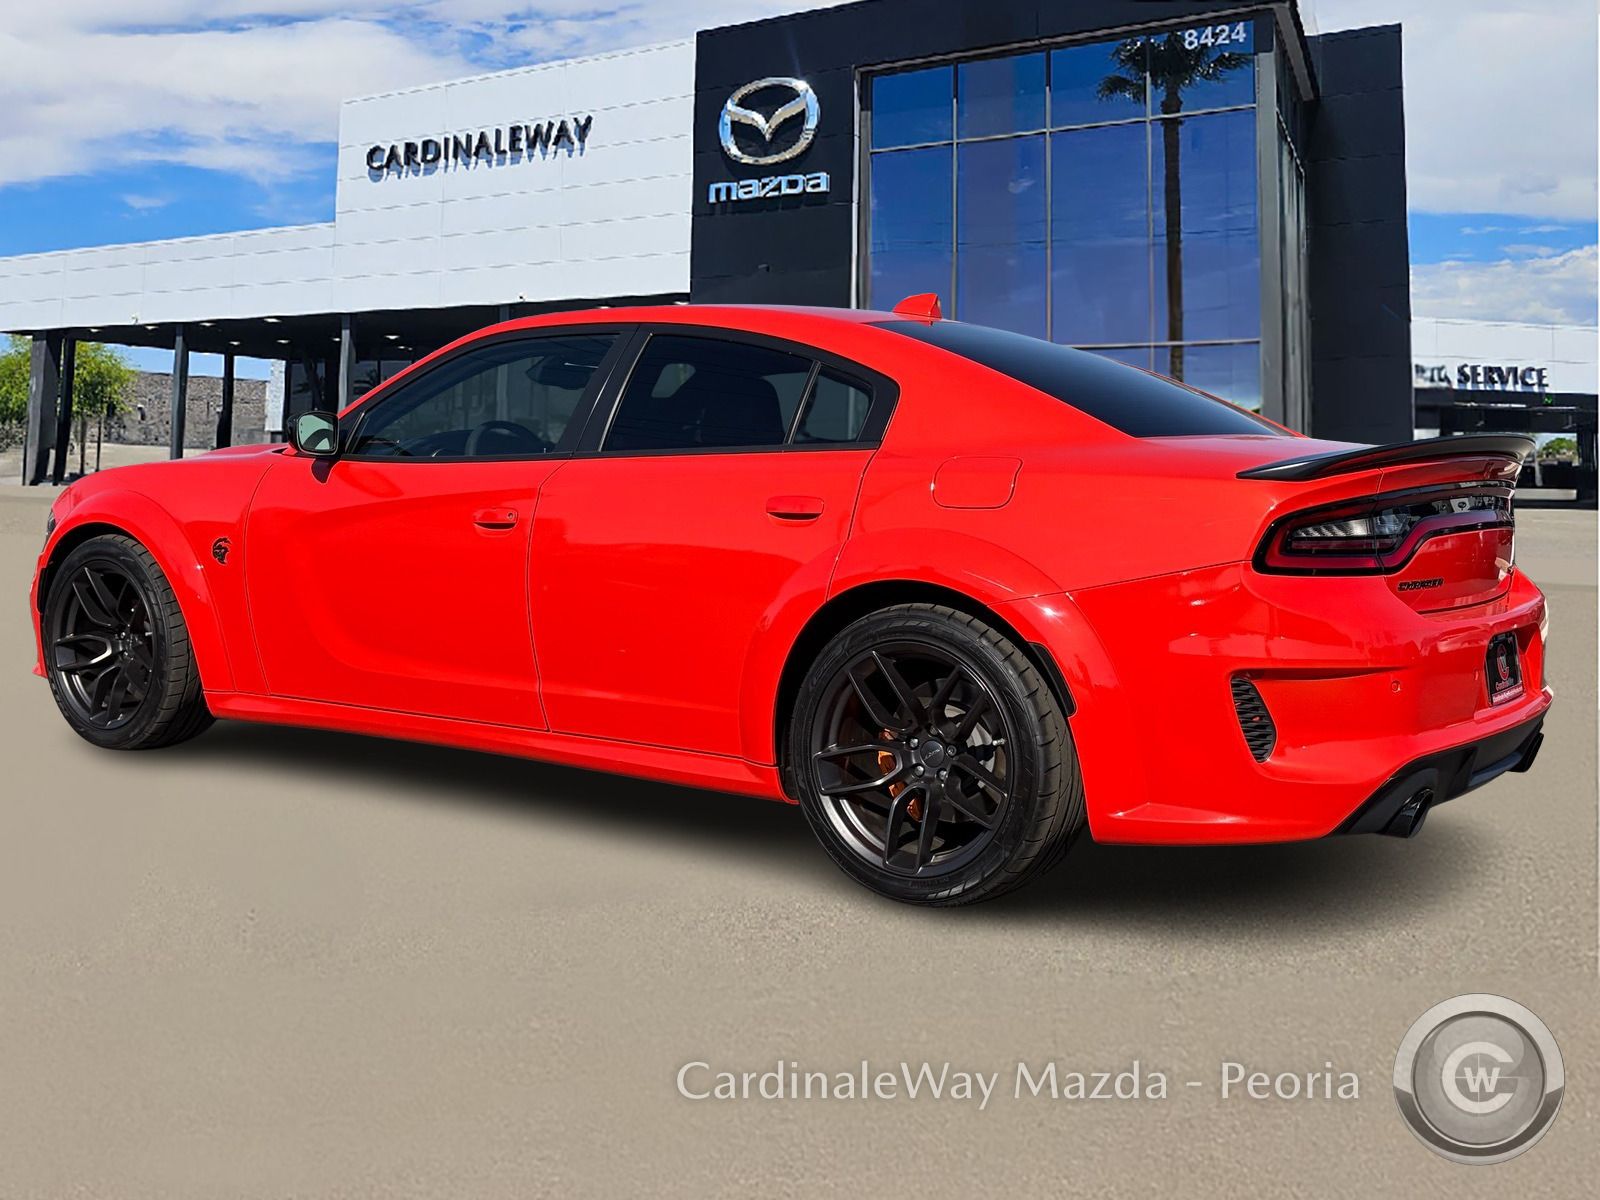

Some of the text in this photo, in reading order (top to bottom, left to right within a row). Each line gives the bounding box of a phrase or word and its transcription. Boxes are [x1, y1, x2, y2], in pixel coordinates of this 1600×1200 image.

[1184, 22, 1246, 50] 8424
[366, 115, 593, 171] CARDINALEWAY
[1457, 363, 1549, 387] SERVICE
